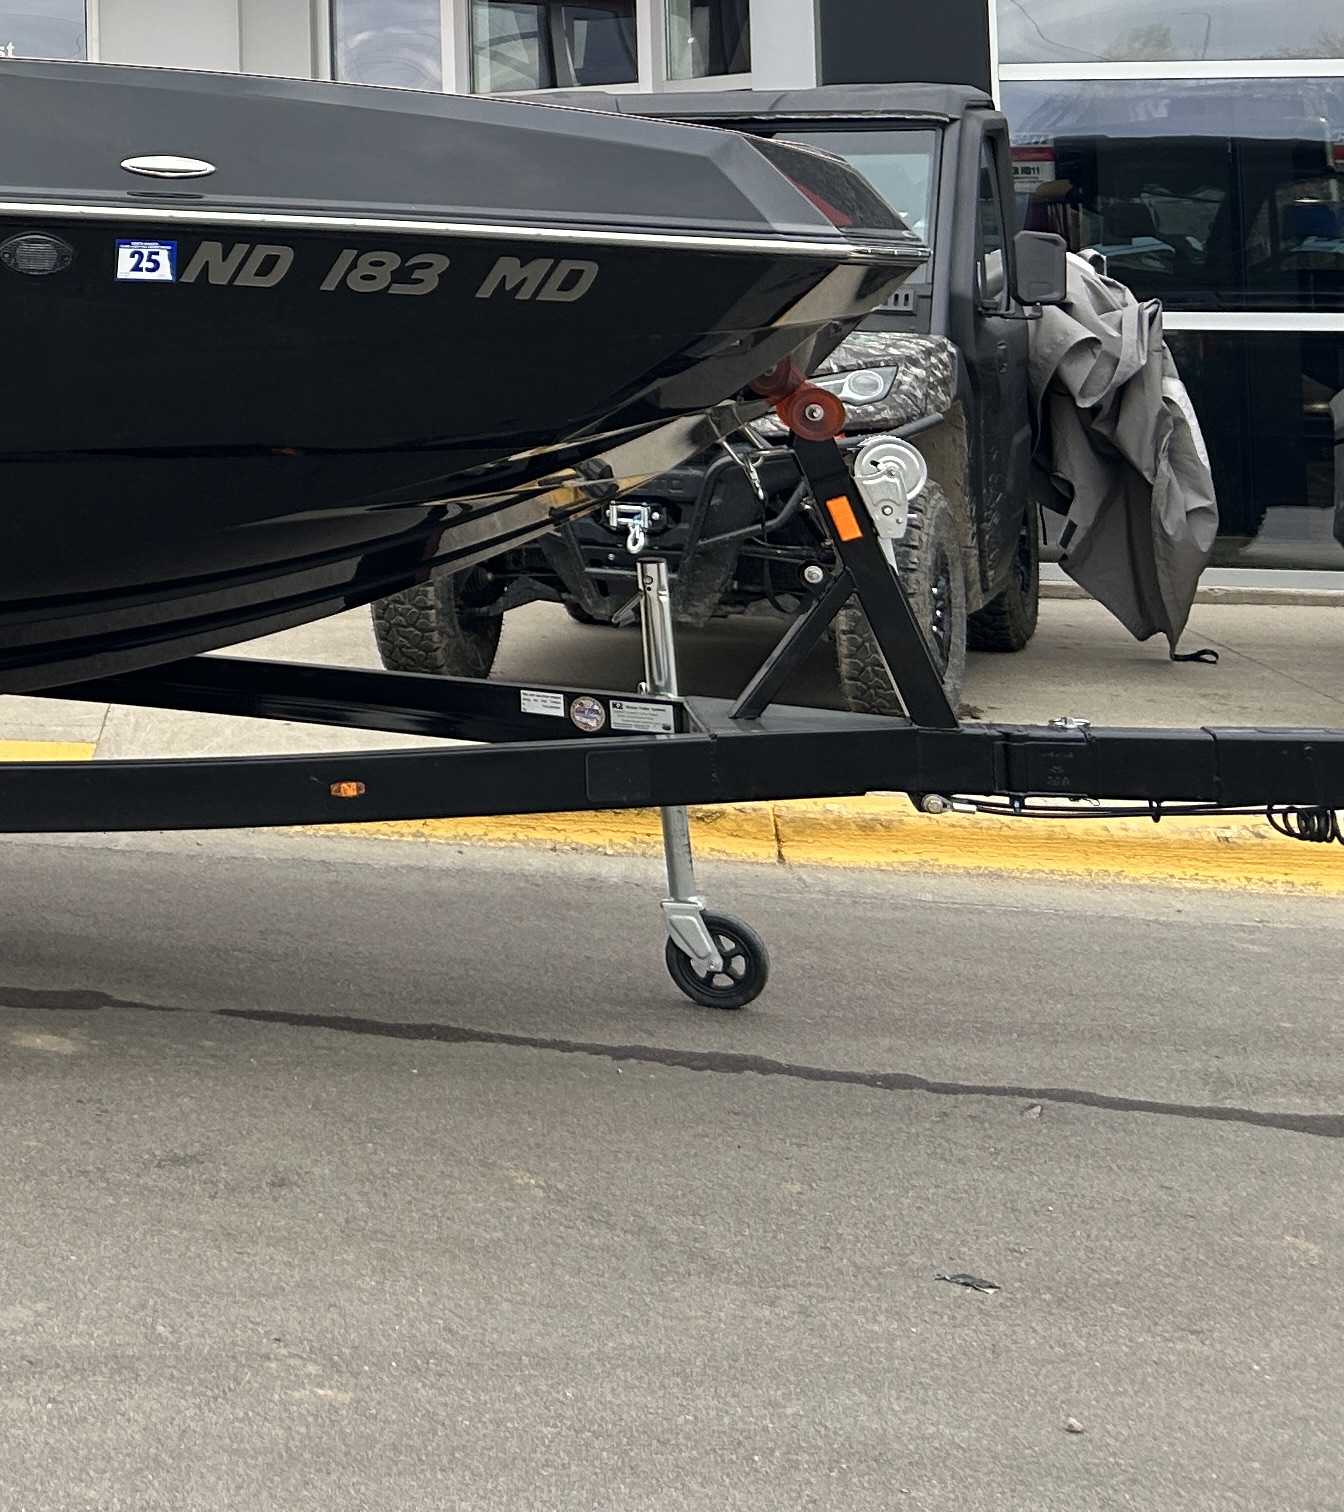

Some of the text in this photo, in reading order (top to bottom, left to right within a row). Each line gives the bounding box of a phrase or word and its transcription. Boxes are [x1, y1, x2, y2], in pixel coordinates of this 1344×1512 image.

[129, 250, 160, 272] 25
[179, 240, 599, 302] ND 183 MD
